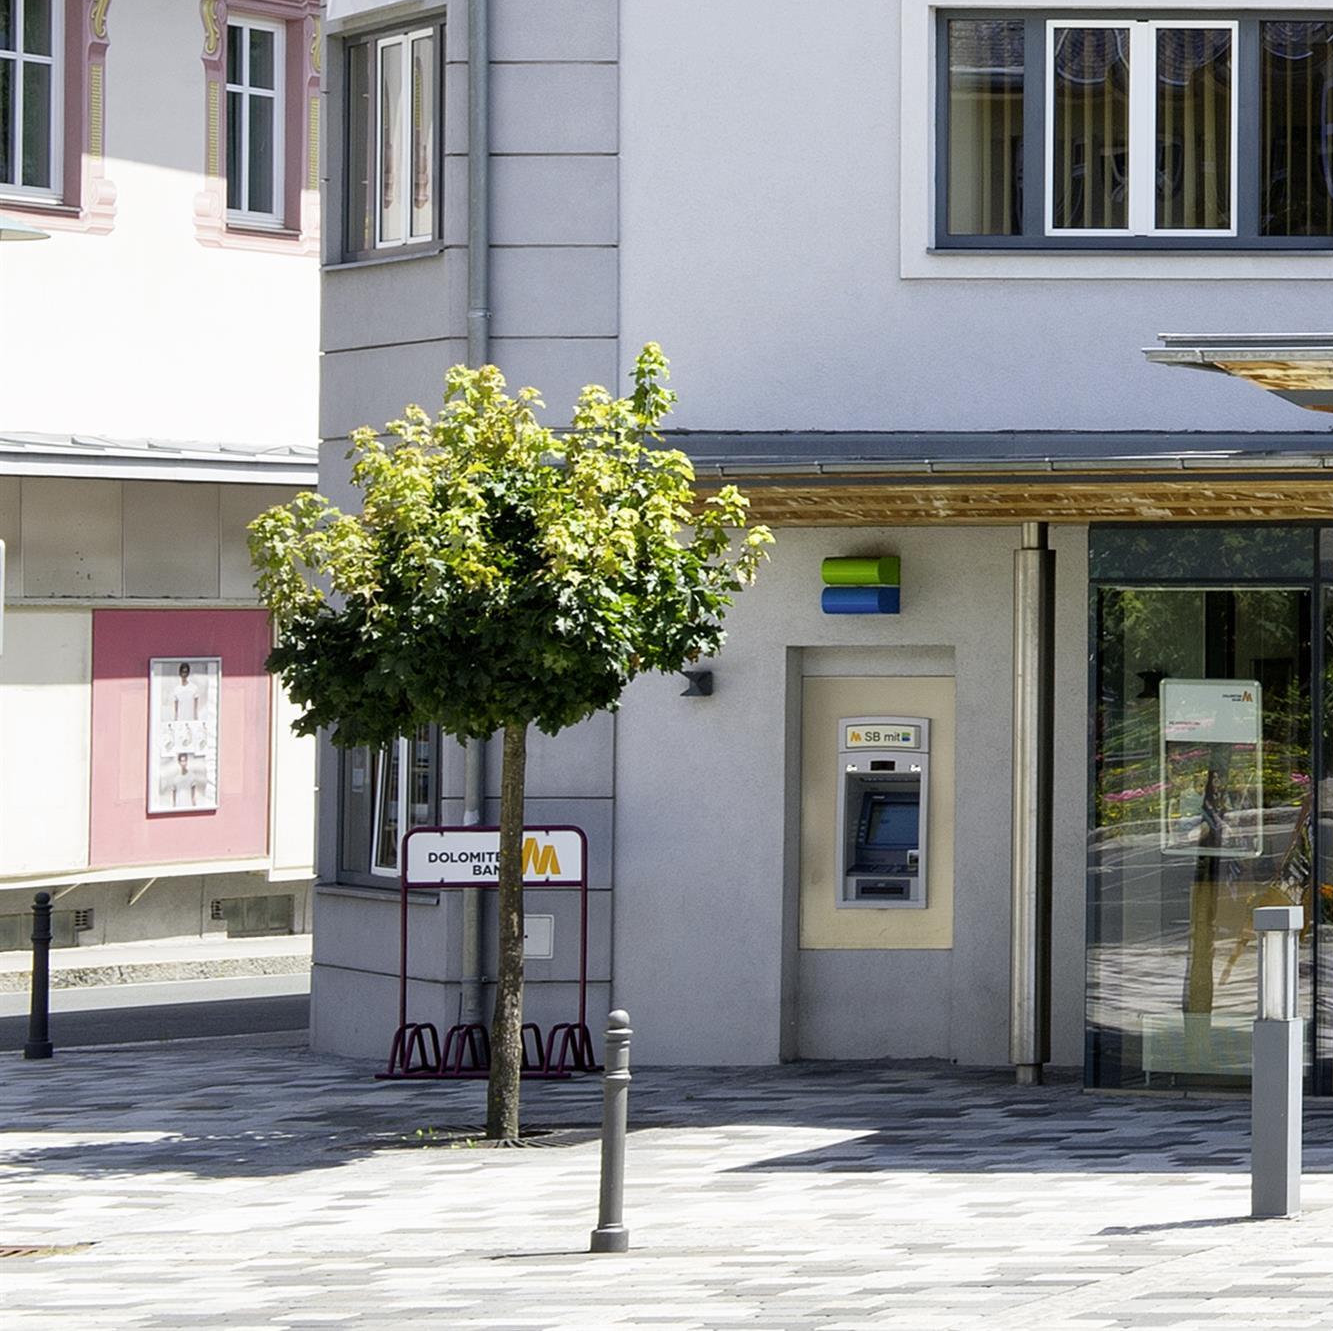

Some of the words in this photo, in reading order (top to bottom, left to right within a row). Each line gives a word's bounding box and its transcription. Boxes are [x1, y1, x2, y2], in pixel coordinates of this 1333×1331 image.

[864, 731, 881, 742] SB
[883, 731, 901, 742] mit
[428, 852, 500, 863] DOLOMITE
[472, 865, 500, 876] BAN
